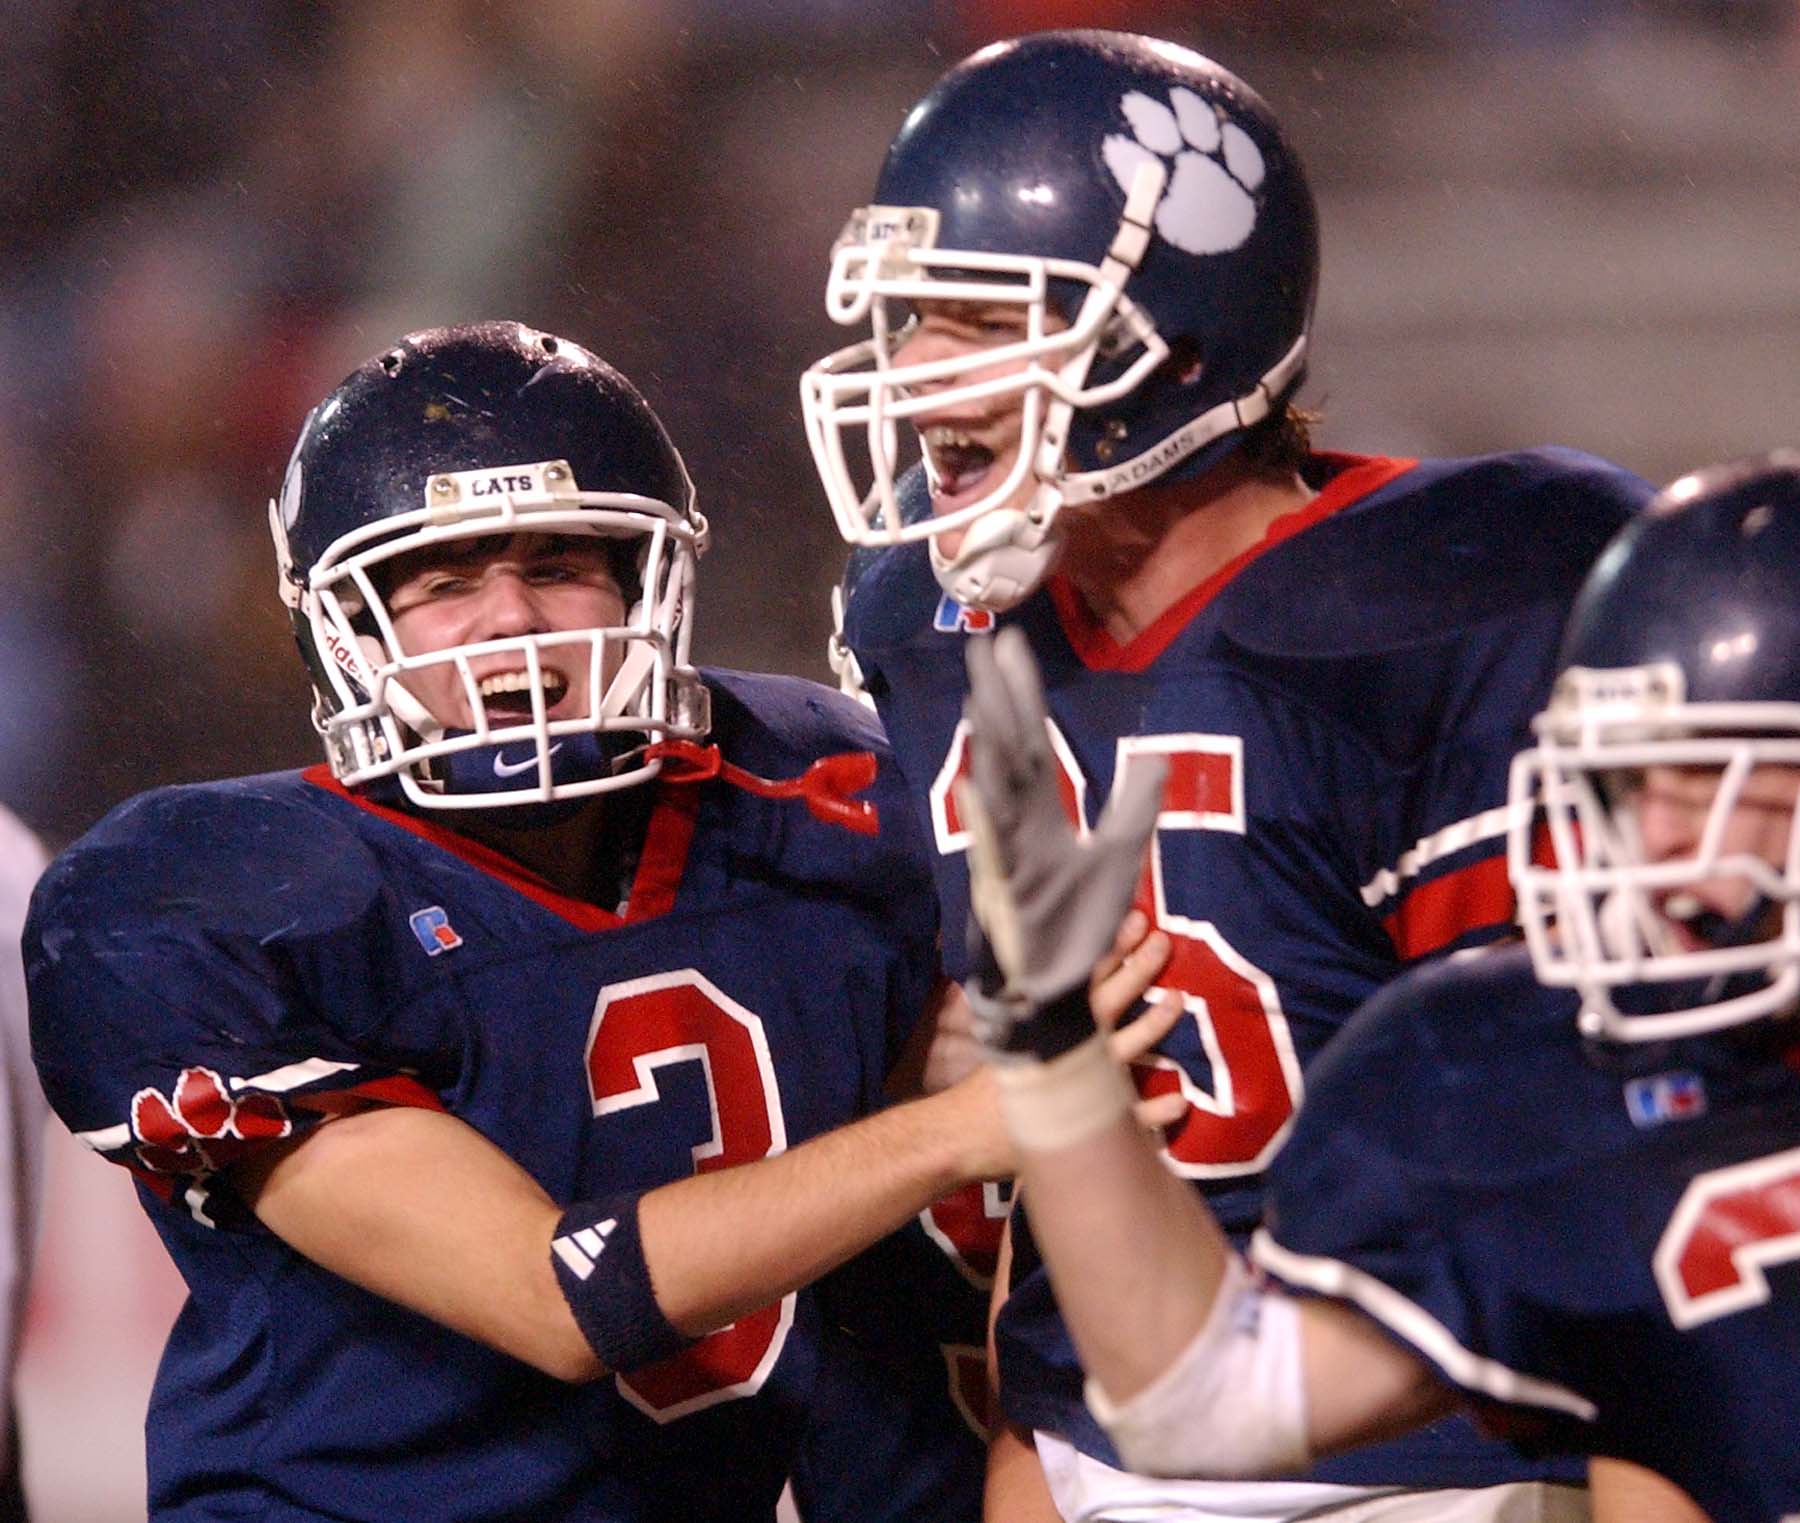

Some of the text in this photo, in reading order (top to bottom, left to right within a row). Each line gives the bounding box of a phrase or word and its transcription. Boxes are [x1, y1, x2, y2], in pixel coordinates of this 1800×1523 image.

[471, 475, 533, 497] CATS
[1110, 431, 1195, 489] ADAMS
[584, 968, 797, 1425] 3
